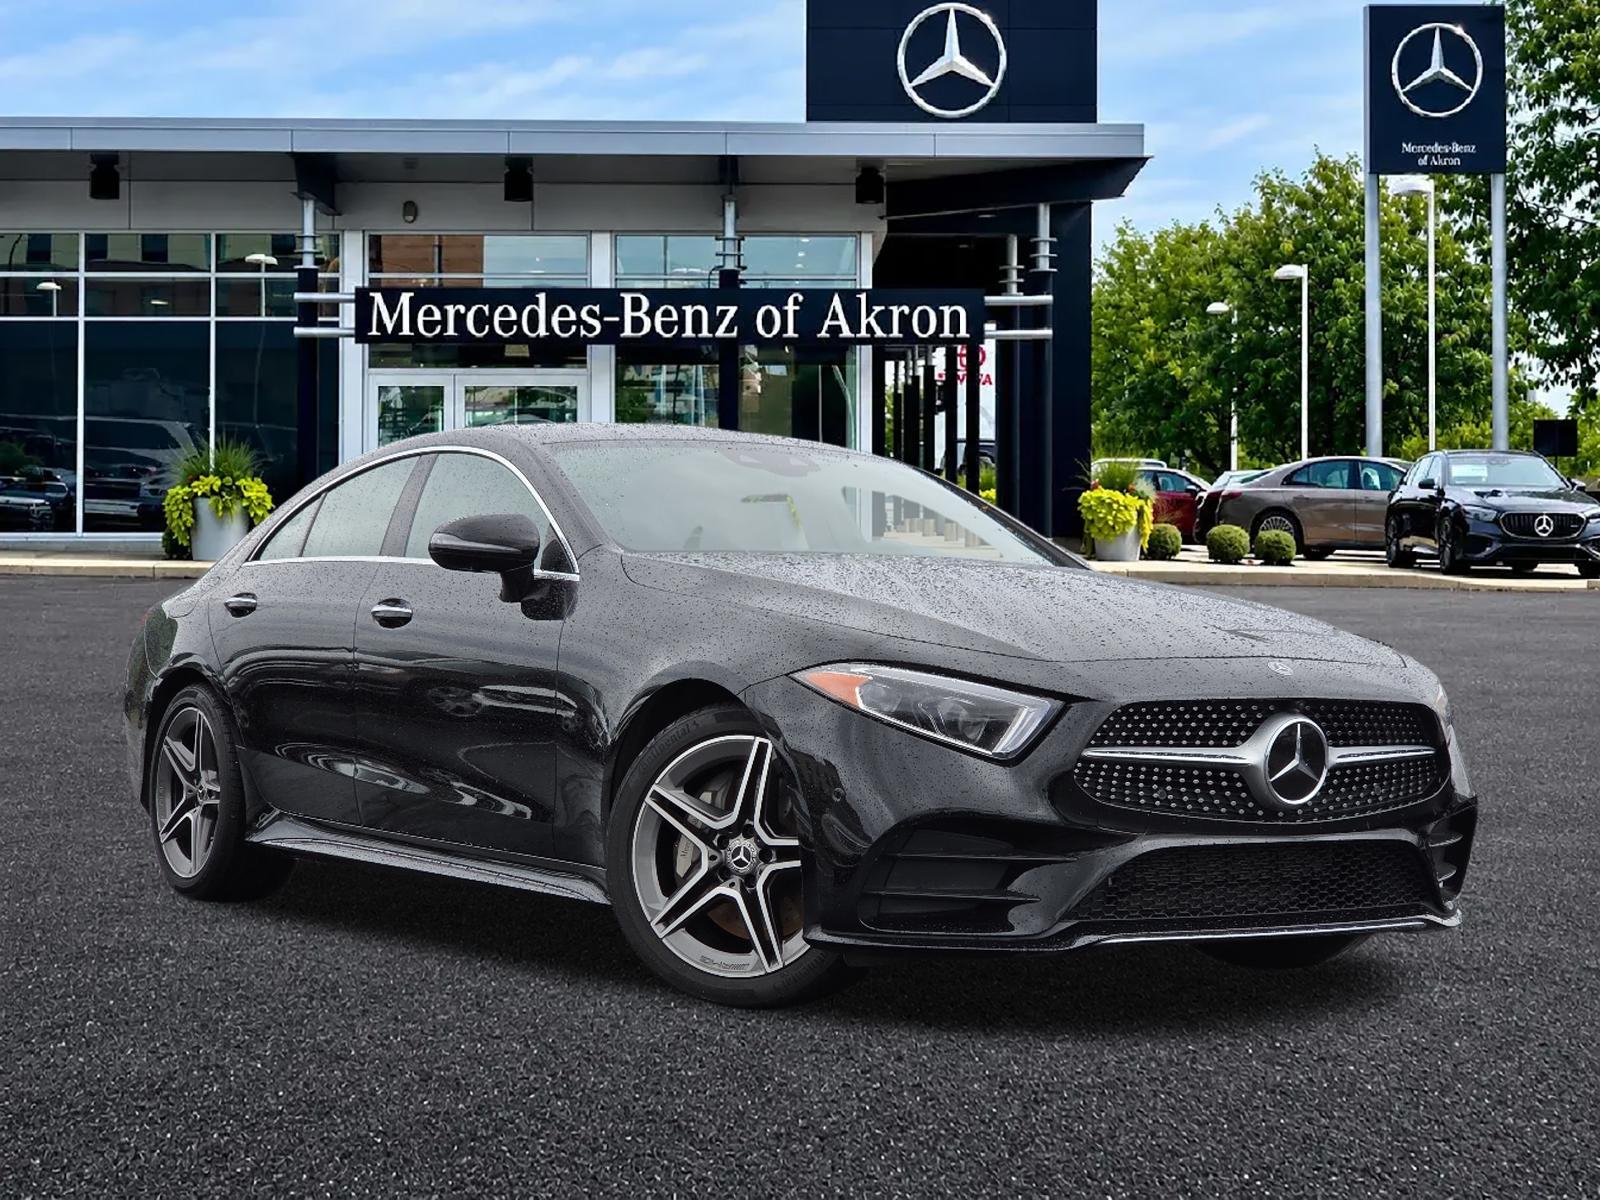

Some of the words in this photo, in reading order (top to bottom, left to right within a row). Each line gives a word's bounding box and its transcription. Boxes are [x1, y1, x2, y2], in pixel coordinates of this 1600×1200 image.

[1401, 141, 1477, 154] Mercedes-Benz
[1417, 154, 1429, 166] of
[1430, 154, 1461, 166] Akron
[367, 291, 738, 339] Mercedes-Benz
[756, 292, 804, 339] of
[816, 292, 970, 339] Akron
